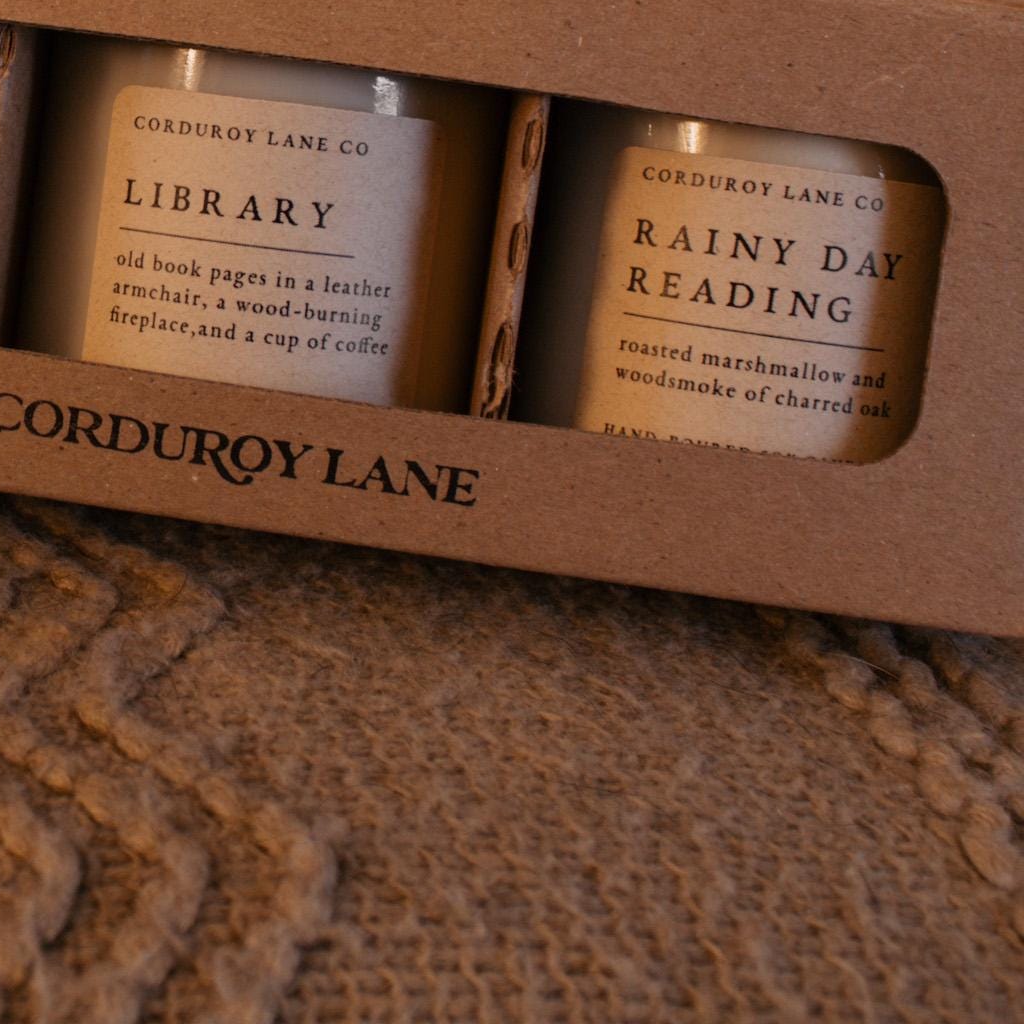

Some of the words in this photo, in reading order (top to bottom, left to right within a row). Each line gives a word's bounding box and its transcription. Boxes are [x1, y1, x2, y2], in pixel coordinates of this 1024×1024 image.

[134, 116, 256, 143] CORDUROY
[267, 131, 328, 152] LANE
[340, 140, 369, 156] CO
[123, 179, 335, 229] LIBRARY
[643, 166, 773, 197] CORDUROY
[784, 186, 845, 207] LANE
[855, 196, 884, 212] CO
[116, 246, 144, 269] old
[153, 250, 201, 277] book
[210, 265, 266, 288] pages
[276, 271, 296, 290] in
[305, 279, 315, 291] a
[324, 277, 391, 298] leather
[633, 219, 796, 265] RAINY
[820, 245, 903, 280] DAY
[112, 280, 208, 310] armchair,
[216, 298, 225, 310] a
[236, 297, 382, 331] wood-burning
[627, 267, 853, 323] READING
[245, 331, 255, 343] a
[264, 333, 299, 353] cup
[307, 328, 330, 350] of
[335, 338, 389, 356] coffee
[619, 337, 692, 363] roasted
[701, 351, 846, 385] marshmallow
[852, 373, 886, 389] and
[615, 366, 736, 398] woodsmoke
[745, 386, 771, 405] of
[775, 391, 853, 415] charred
[860, 400, 891, 418] oak
[323, 448, 480, 507] LANE
